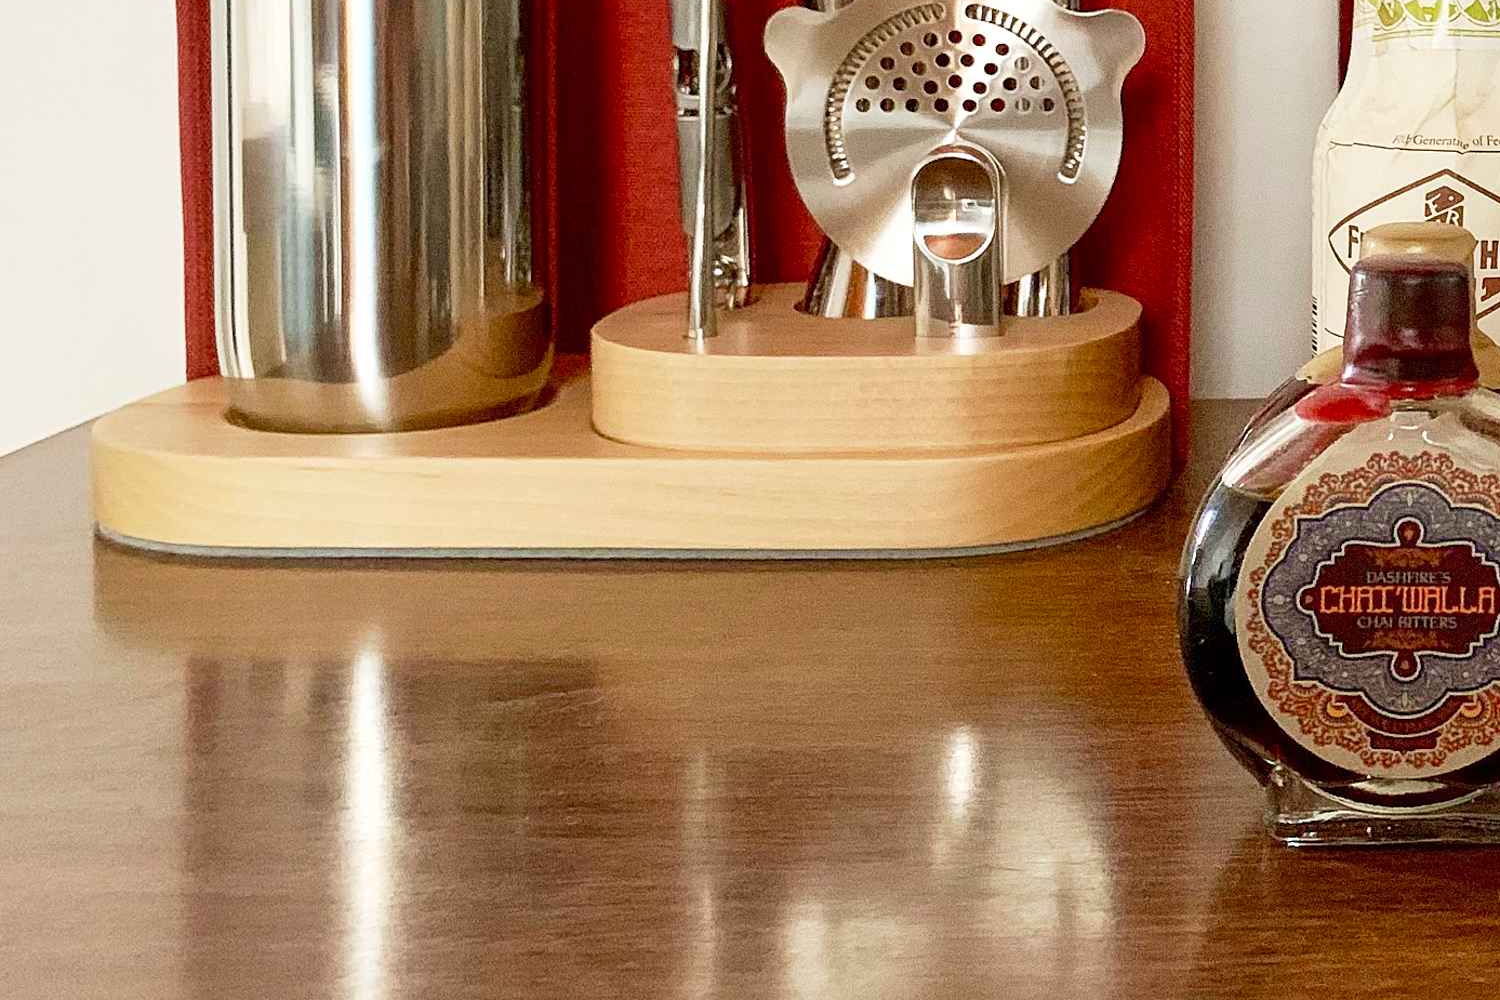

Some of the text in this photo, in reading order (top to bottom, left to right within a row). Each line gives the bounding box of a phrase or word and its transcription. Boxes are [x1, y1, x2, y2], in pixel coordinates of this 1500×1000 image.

[1472, 134, 1484, 146] of
[1366, 571, 1452, 584] DASHFIRE'S
[1356, 616, 1458, 630] CHAI BITTERS
